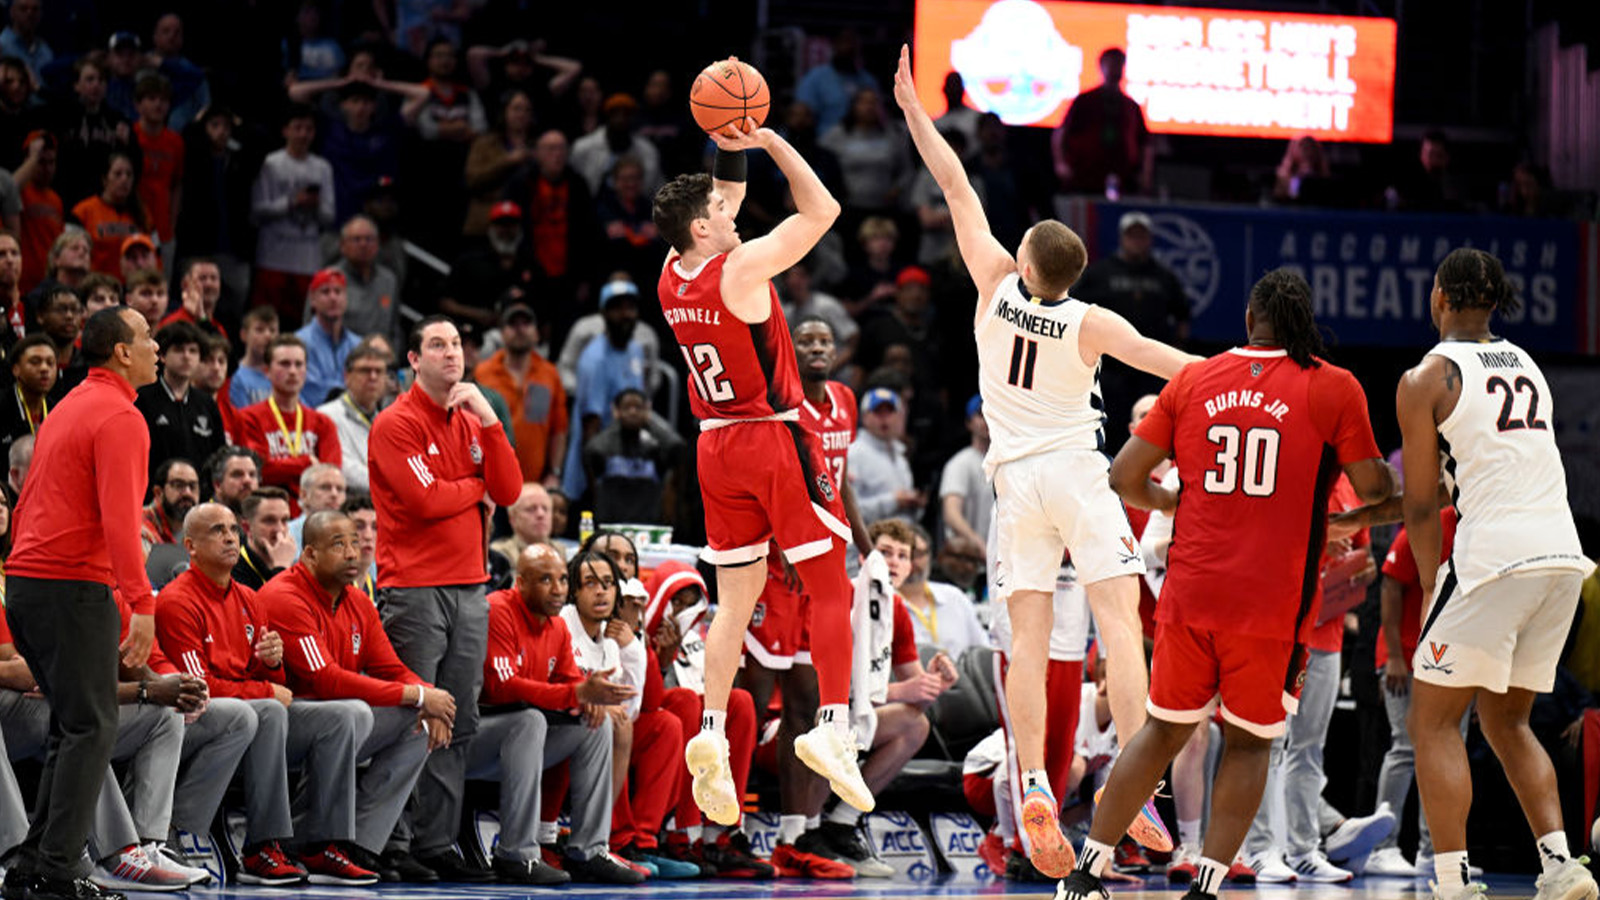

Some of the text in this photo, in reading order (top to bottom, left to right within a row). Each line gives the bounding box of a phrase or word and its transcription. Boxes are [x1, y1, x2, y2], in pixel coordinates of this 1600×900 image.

[1280, 229, 1558, 269] ACCOMPISH
[1279, 262, 1558, 326] REATSS
[995, 298, 1068, 340] McKNEELY
[680, 343, 736, 402] 12
[1008, 334, 1038, 391] 11
[1476, 351, 1524, 369] MINOR
[1204, 389, 1264, 418] BURNS
[1486, 375, 1548, 432] 22
[1203, 424, 1281, 497] 30
[881, 830, 925, 852] ACC
